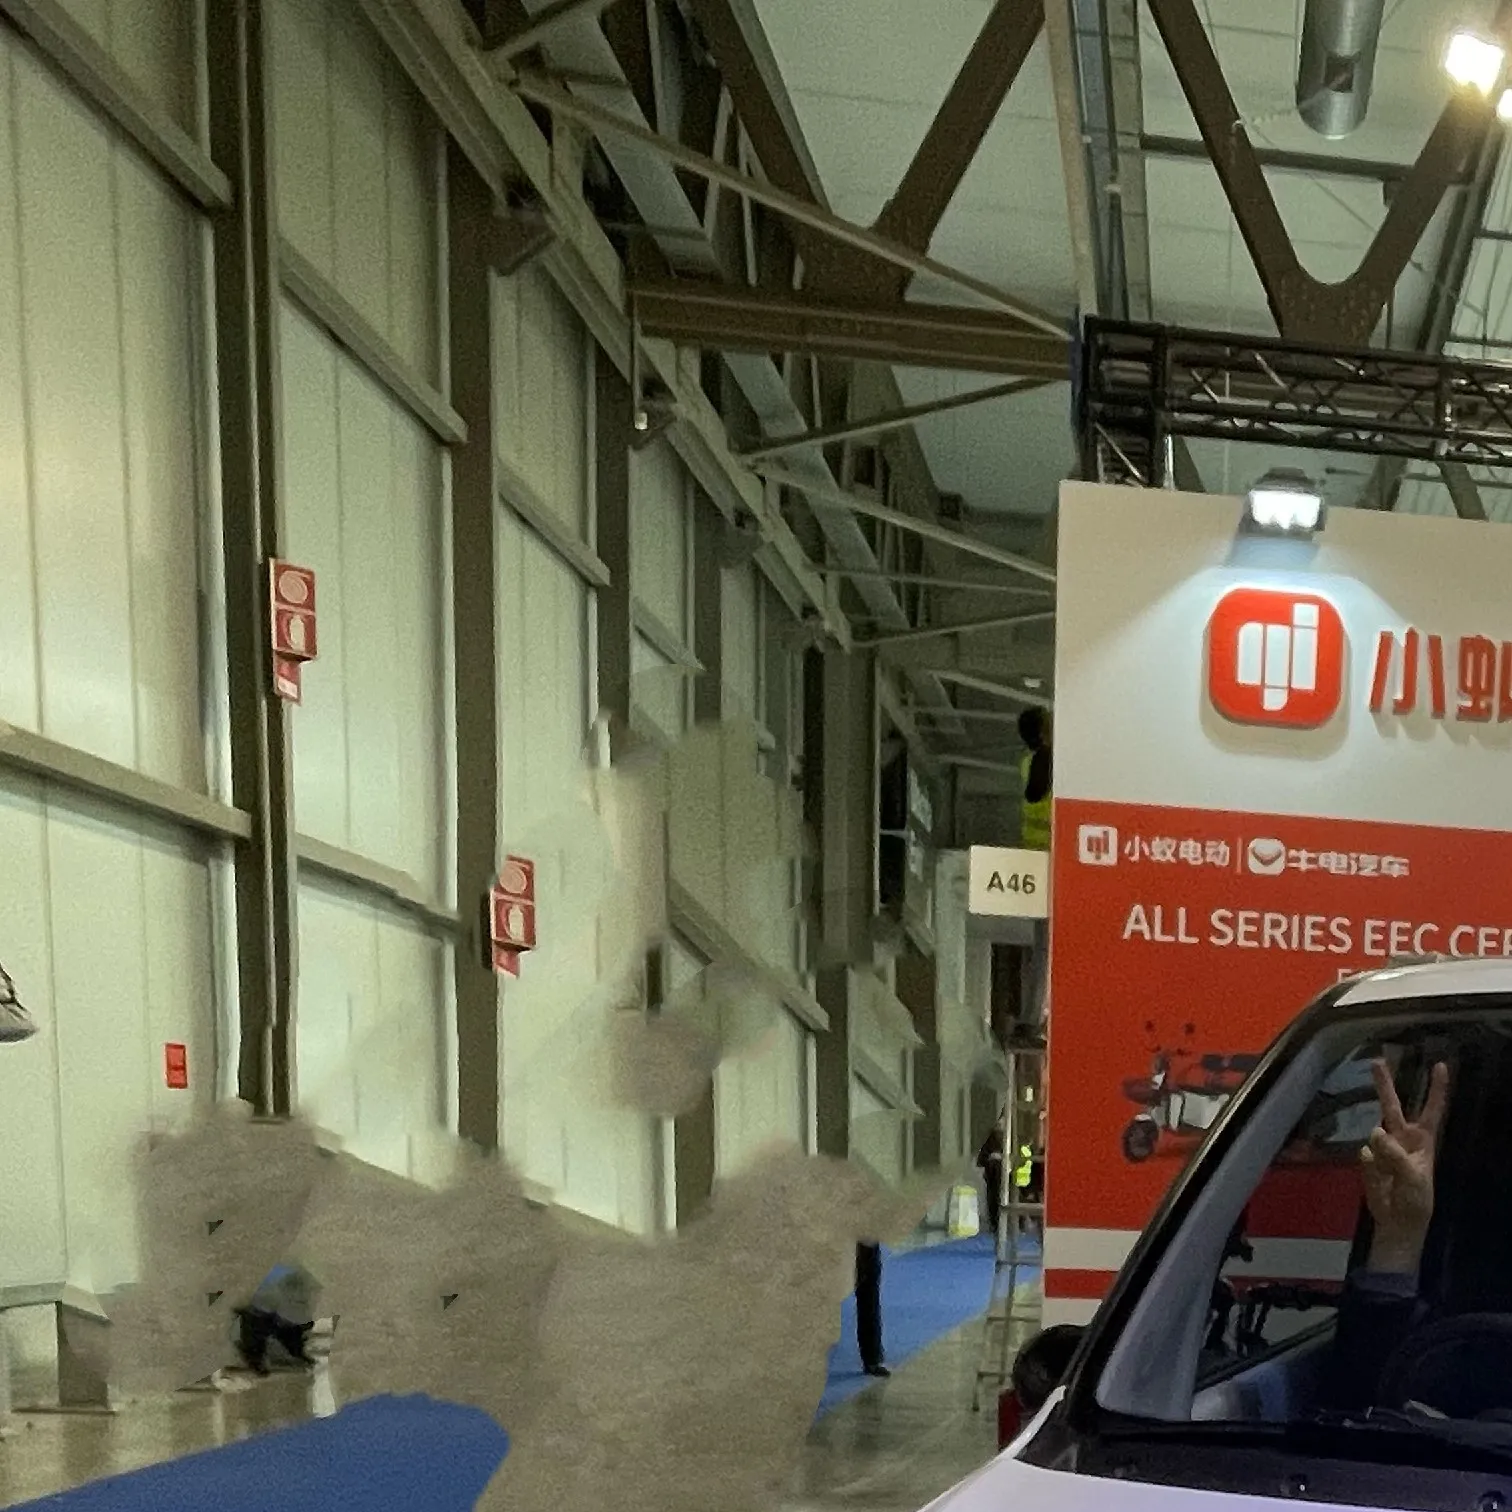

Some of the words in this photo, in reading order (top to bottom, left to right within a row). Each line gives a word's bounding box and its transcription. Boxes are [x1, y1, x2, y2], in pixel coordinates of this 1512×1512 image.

[1124, 835, 1230, 867] 小蚁电动
[986, 871, 1036, 894] A46
[1123, 904, 1200, 944] ALL
[1209, 907, 1353, 955] SERIES
[1363, 918, 1438, 957] EEC
